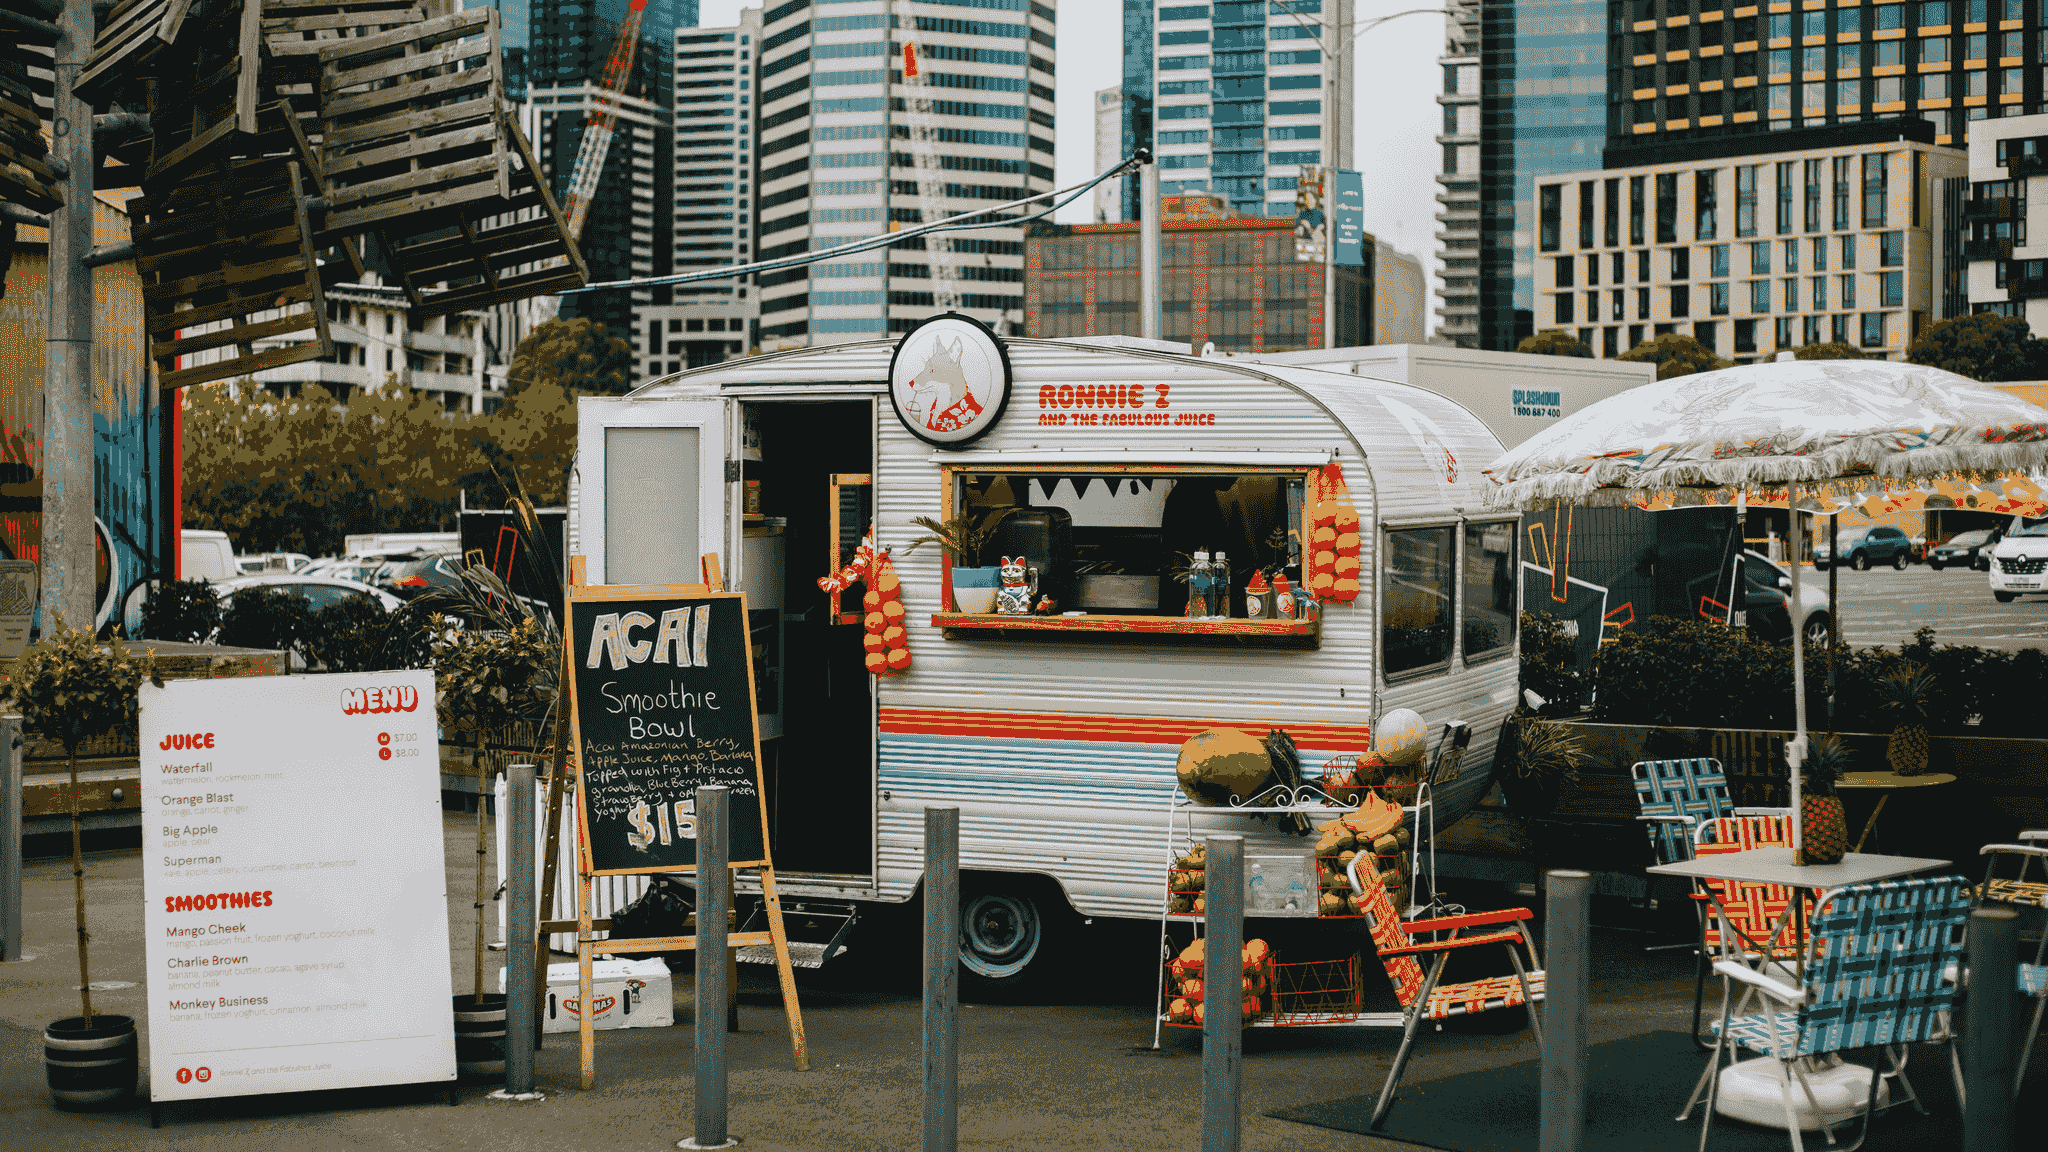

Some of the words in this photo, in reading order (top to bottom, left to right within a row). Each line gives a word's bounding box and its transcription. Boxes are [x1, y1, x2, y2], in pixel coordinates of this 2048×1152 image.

[1038, 383, 1145, 409] RONNIE
[1155, 383, 1170, 409] Z
[1038, 413, 1069, 426] AND
[1071, 413, 1098, 426] THE
[1102, 413, 1170, 426] FABULOUS
[1174, 413, 1216, 426] JUICE
[586, 604, 711, 671] ACAI
[341, 685, 418, 715] MENU
[601, 679, 721, 714] Smoothie
[629, 714, 696, 740] Bowl
[159, 733, 215, 751] JUICE
[394, 733, 418, 743] $7.00
[621, 740, 688, 751] Amazonian
[395, 748, 420, 758] $8.00
[1711, 731, 1789, 777] QUEE
[160, 762, 213, 774] Waterfall
[587, 755, 620, 770] Apple
[264, 772, 284, 780] mint
[586, 766, 629, 784] Topped
[630, 766, 660, 777] with
[662, 764, 681, 778] Fig
[161, 795, 204, 807] Orange
[206, 793, 234, 804] Blast
[222, 805, 250, 815] ginger
[162, 825, 181, 839] Big
[182, 824, 219, 838] Apple
[163, 856, 222, 868] Superman
[165, 890, 273, 913] SMOOTHIES
[166, 926, 206, 939] Mango
[208, 922, 247, 935] Cheek
[199, 938, 232, 947] passion
[254, 933, 282, 943] frozen
[357, 927, 375, 936] milk
[167, 956, 210, 969] Charlie
[212, 955, 249, 966] Brown
[202, 968, 233, 979] peanut
[167, 980, 201, 991] almond
[202, 979, 221, 988] milk
[169, 998, 216, 1012] Monkey
[219, 995, 269, 1008] Business
[203, 1010, 232, 1020] frozen
[315, 1001, 348, 1012] almond
[566, 998, 613, 1012] BANAS
